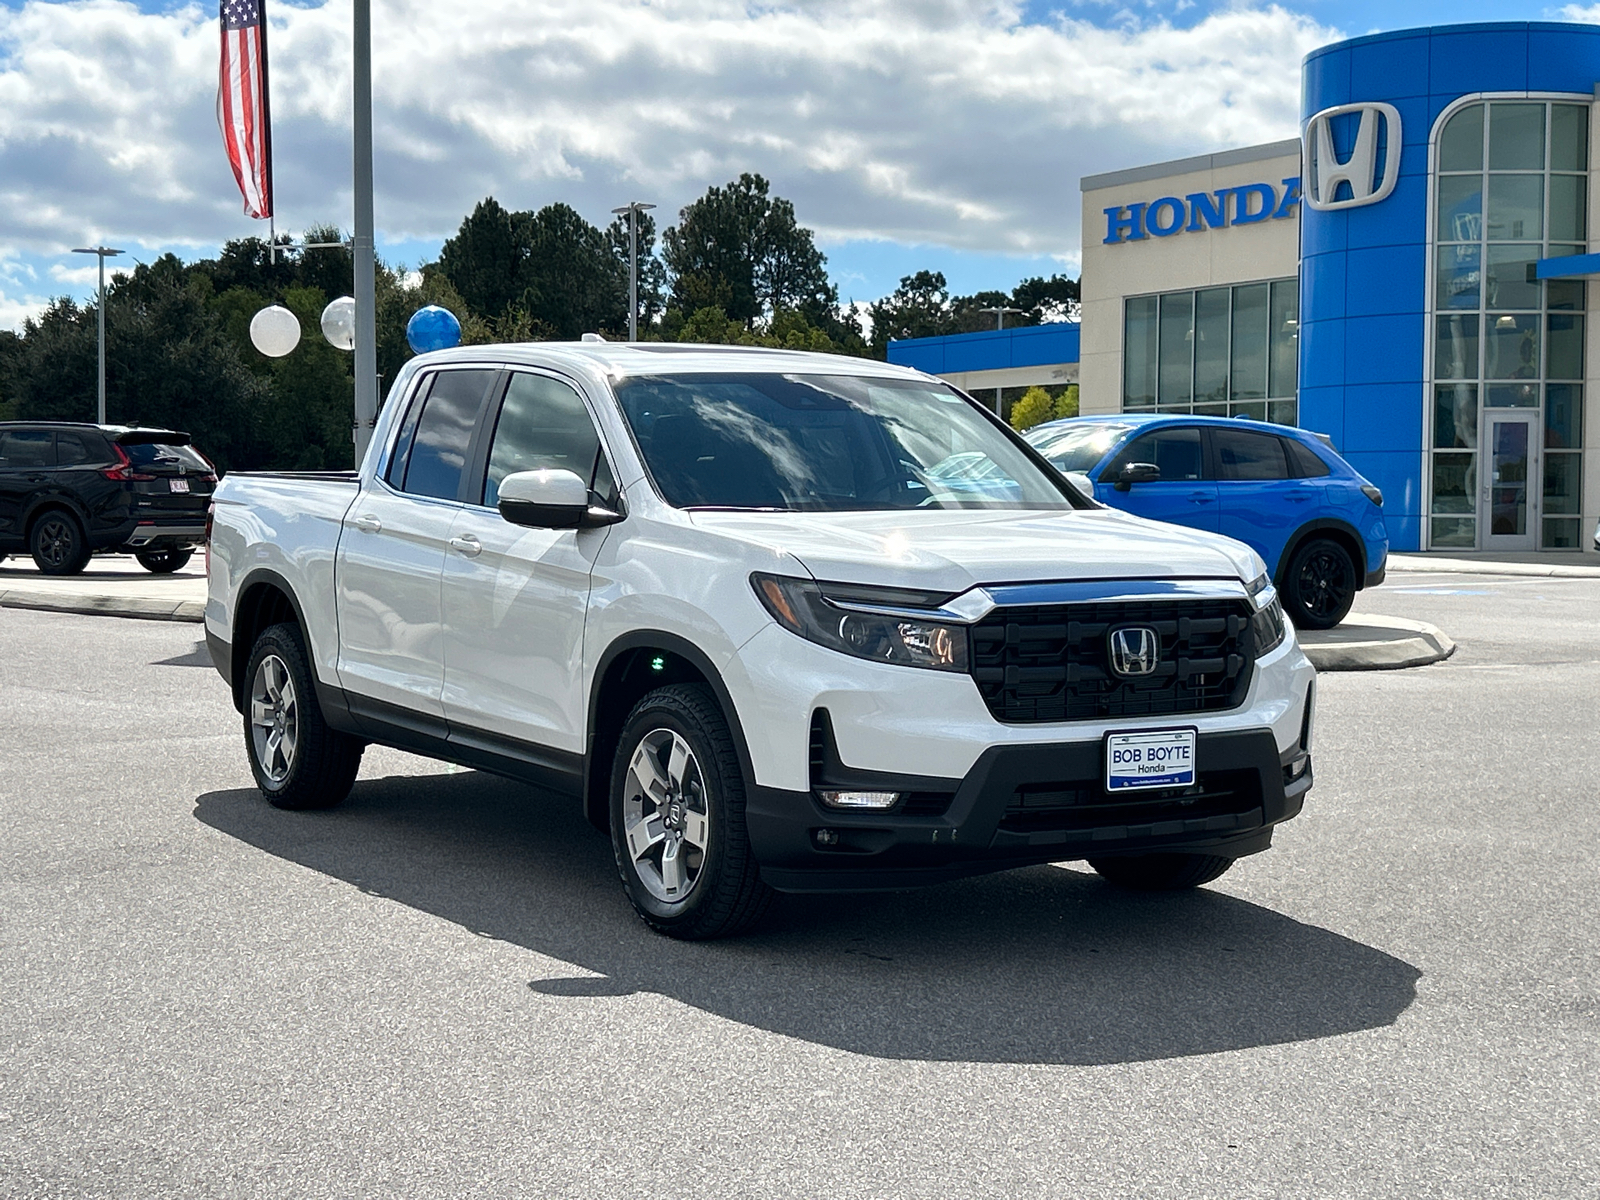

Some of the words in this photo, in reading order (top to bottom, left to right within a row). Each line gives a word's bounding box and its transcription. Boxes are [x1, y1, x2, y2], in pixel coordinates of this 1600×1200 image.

[1113, 749, 1142, 764] BOB
[1147, 746, 1190, 761] BOYTE
[1138, 764, 1166, 773] Honda
